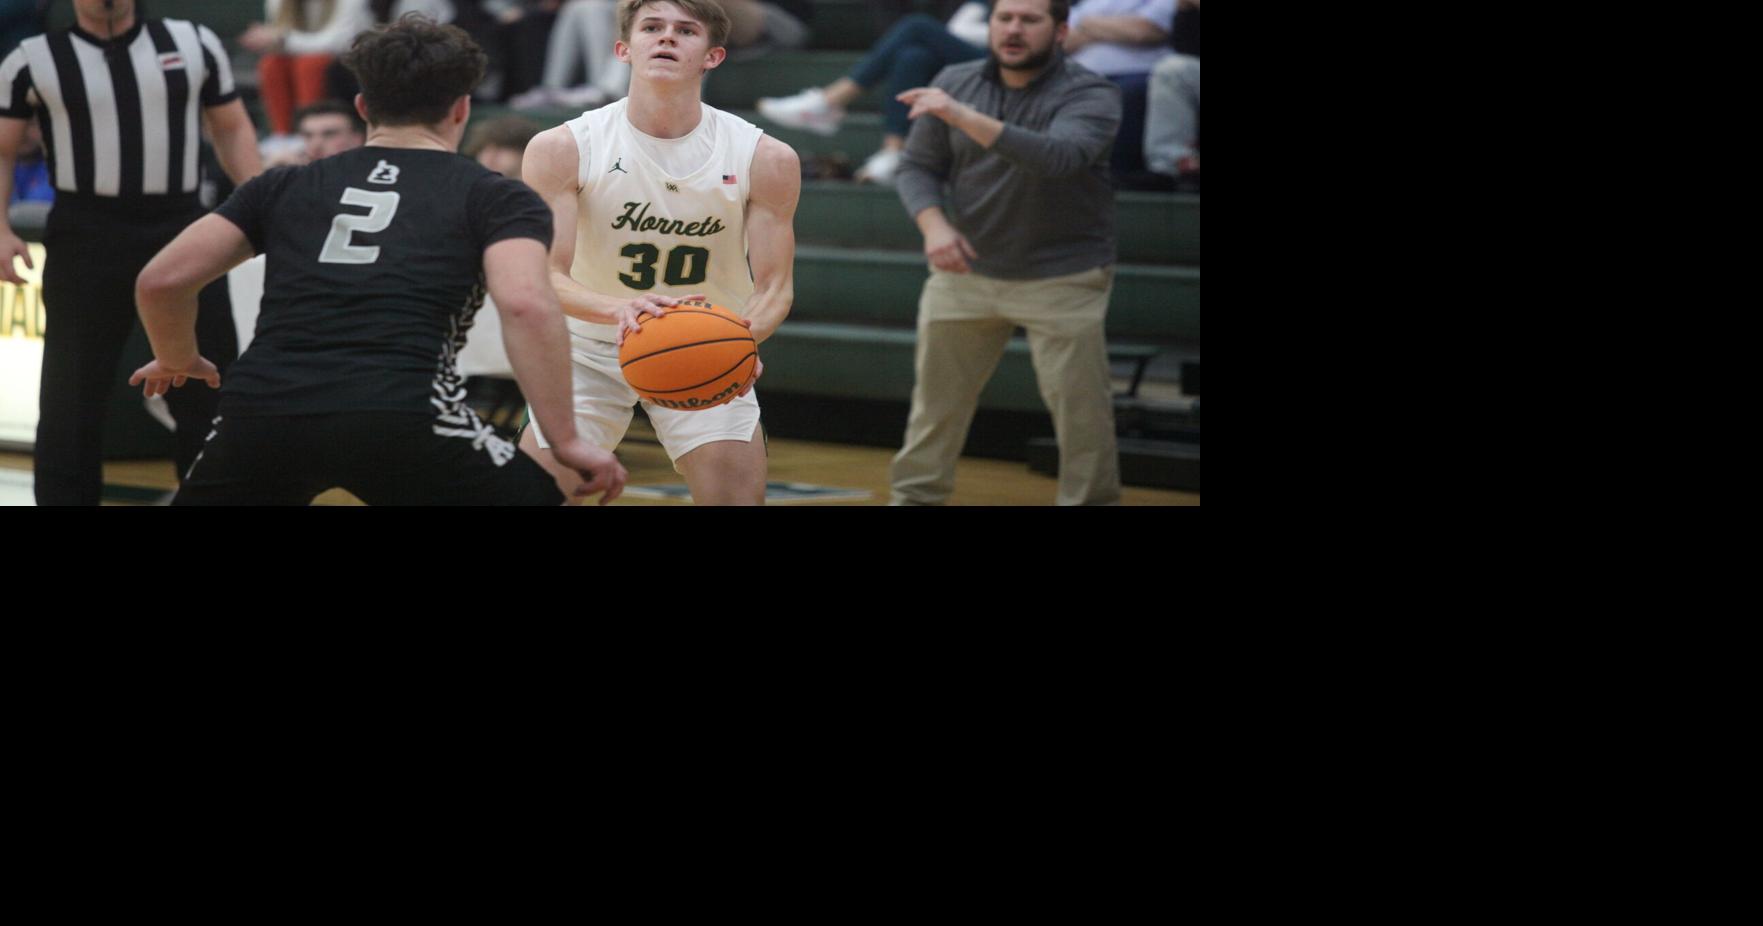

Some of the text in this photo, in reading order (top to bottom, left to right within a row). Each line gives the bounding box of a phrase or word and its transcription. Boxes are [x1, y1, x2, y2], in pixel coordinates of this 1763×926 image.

[318, 187, 400, 264] 2
[611, 201, 726, 237] Hornets
[617, 242, 710, 291] 30
